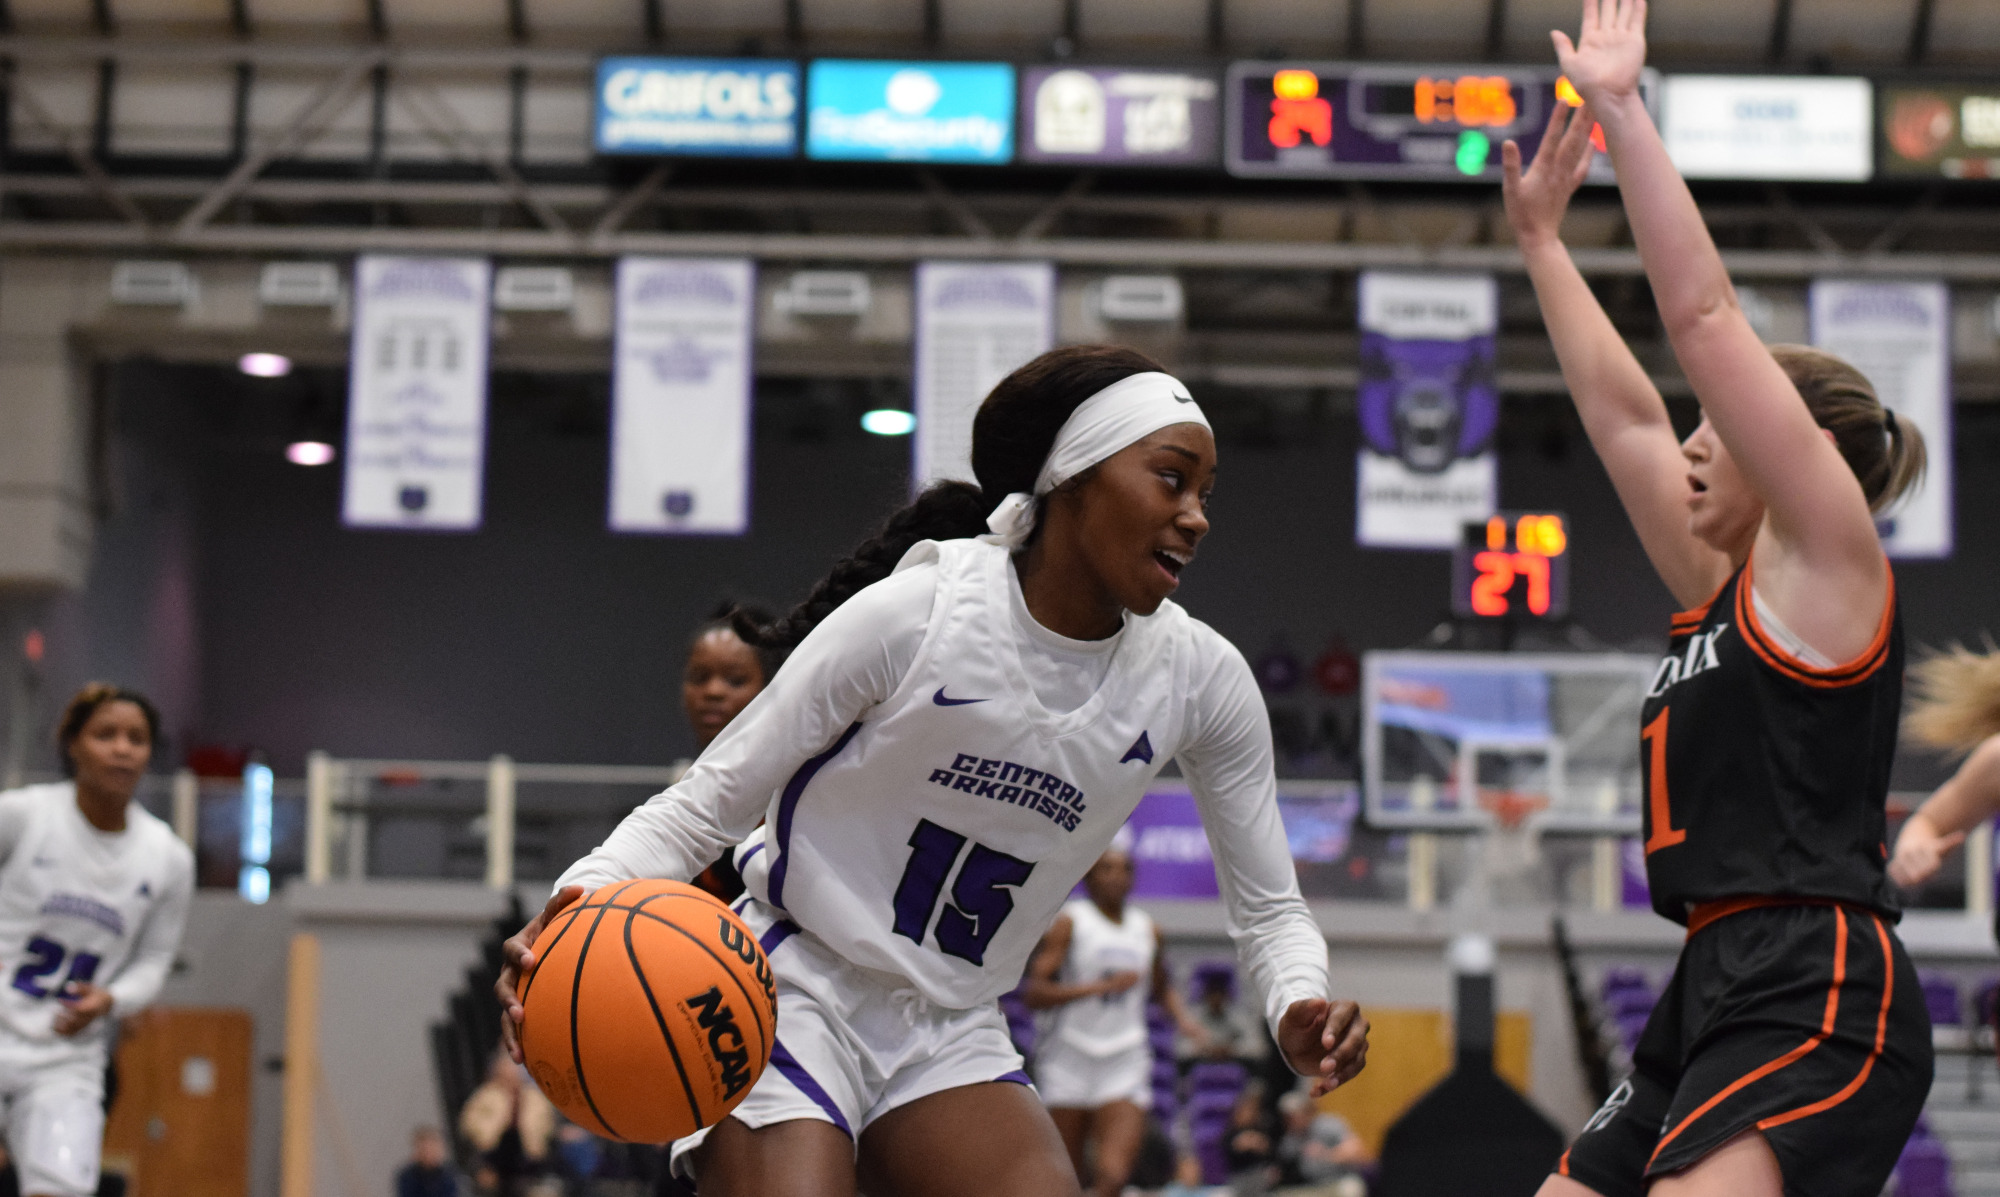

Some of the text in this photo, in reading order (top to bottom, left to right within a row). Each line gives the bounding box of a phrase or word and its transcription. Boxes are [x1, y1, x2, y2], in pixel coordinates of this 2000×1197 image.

[1471, 551, 1550, 616] 27
[928, 769, 1082, 833] ARKANSAS
[951, 753, 1086, 813] CENTRAL
[892, 817, 1038, 967] 15
[686, 985, 751, 1103] NCAA
